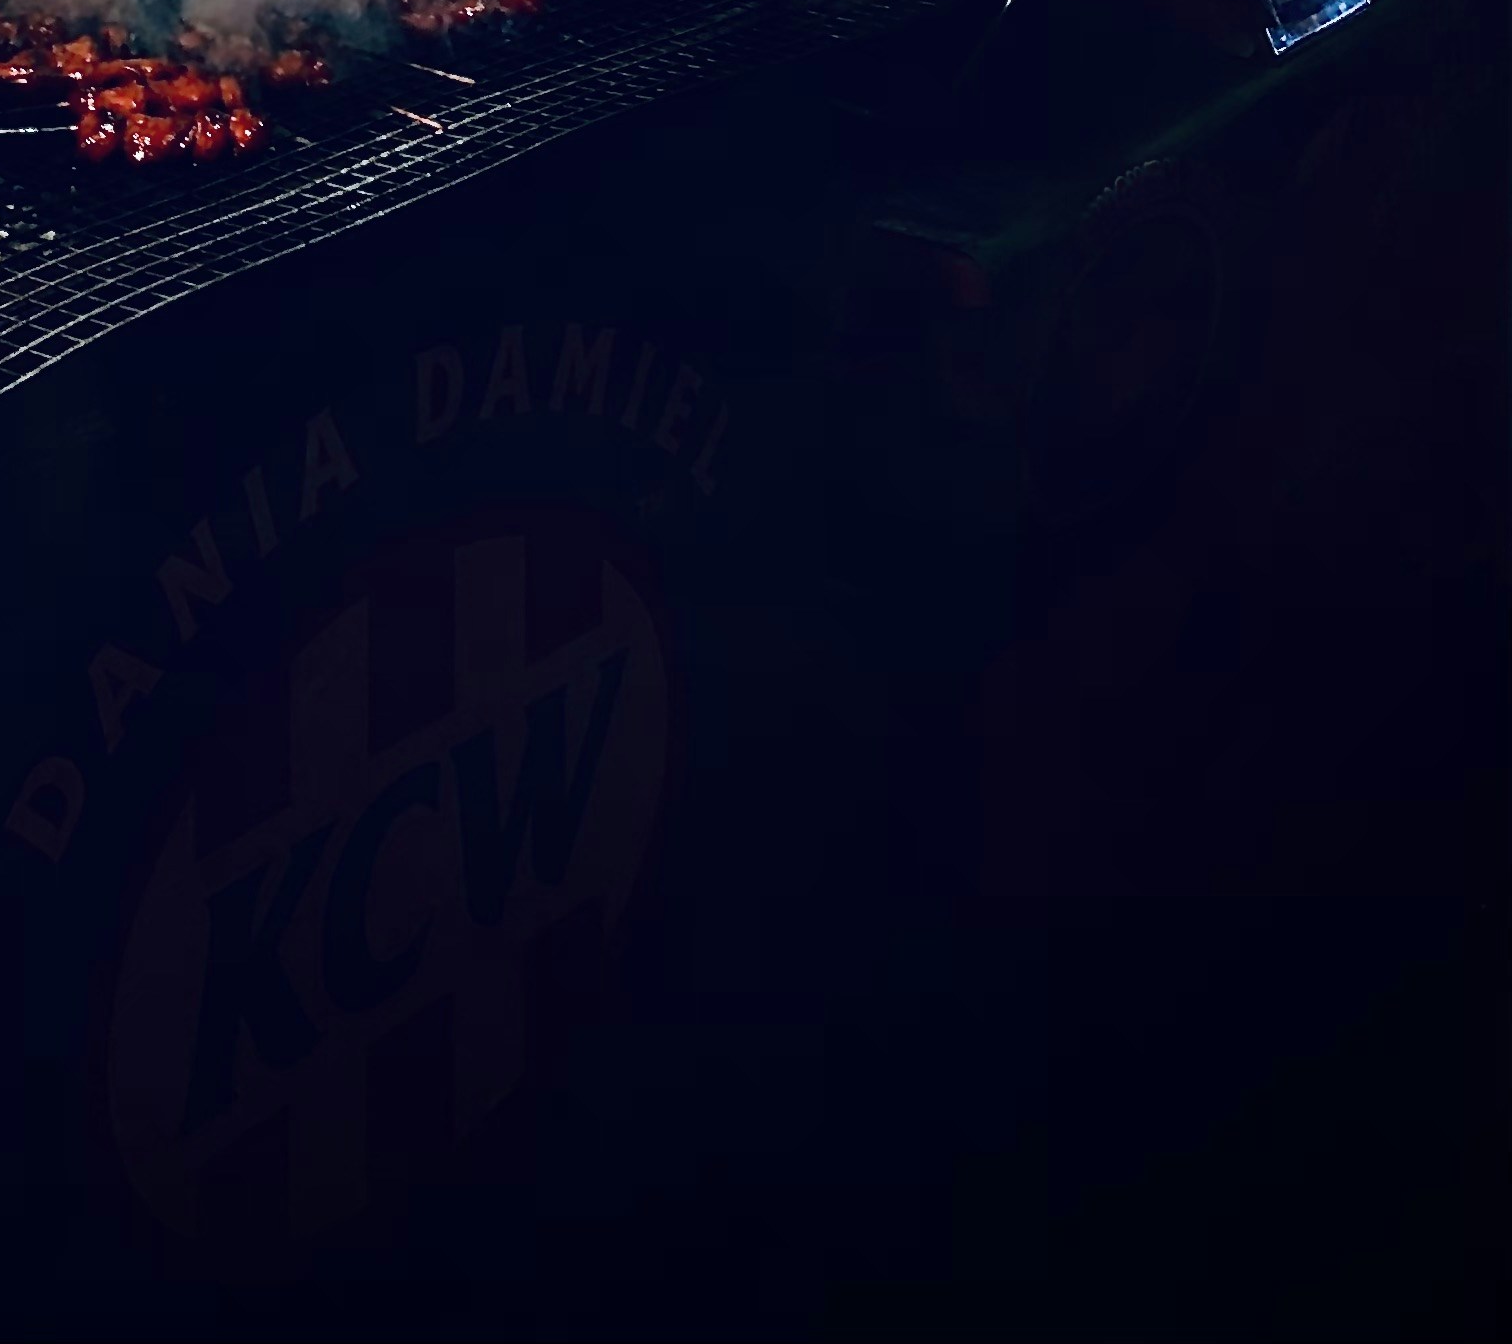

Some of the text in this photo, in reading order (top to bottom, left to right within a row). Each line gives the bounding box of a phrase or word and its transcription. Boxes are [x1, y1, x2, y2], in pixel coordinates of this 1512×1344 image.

[3, 320, 730, 864] DANIA DAMIEL
[180, 646, 630, 1138] KCW
